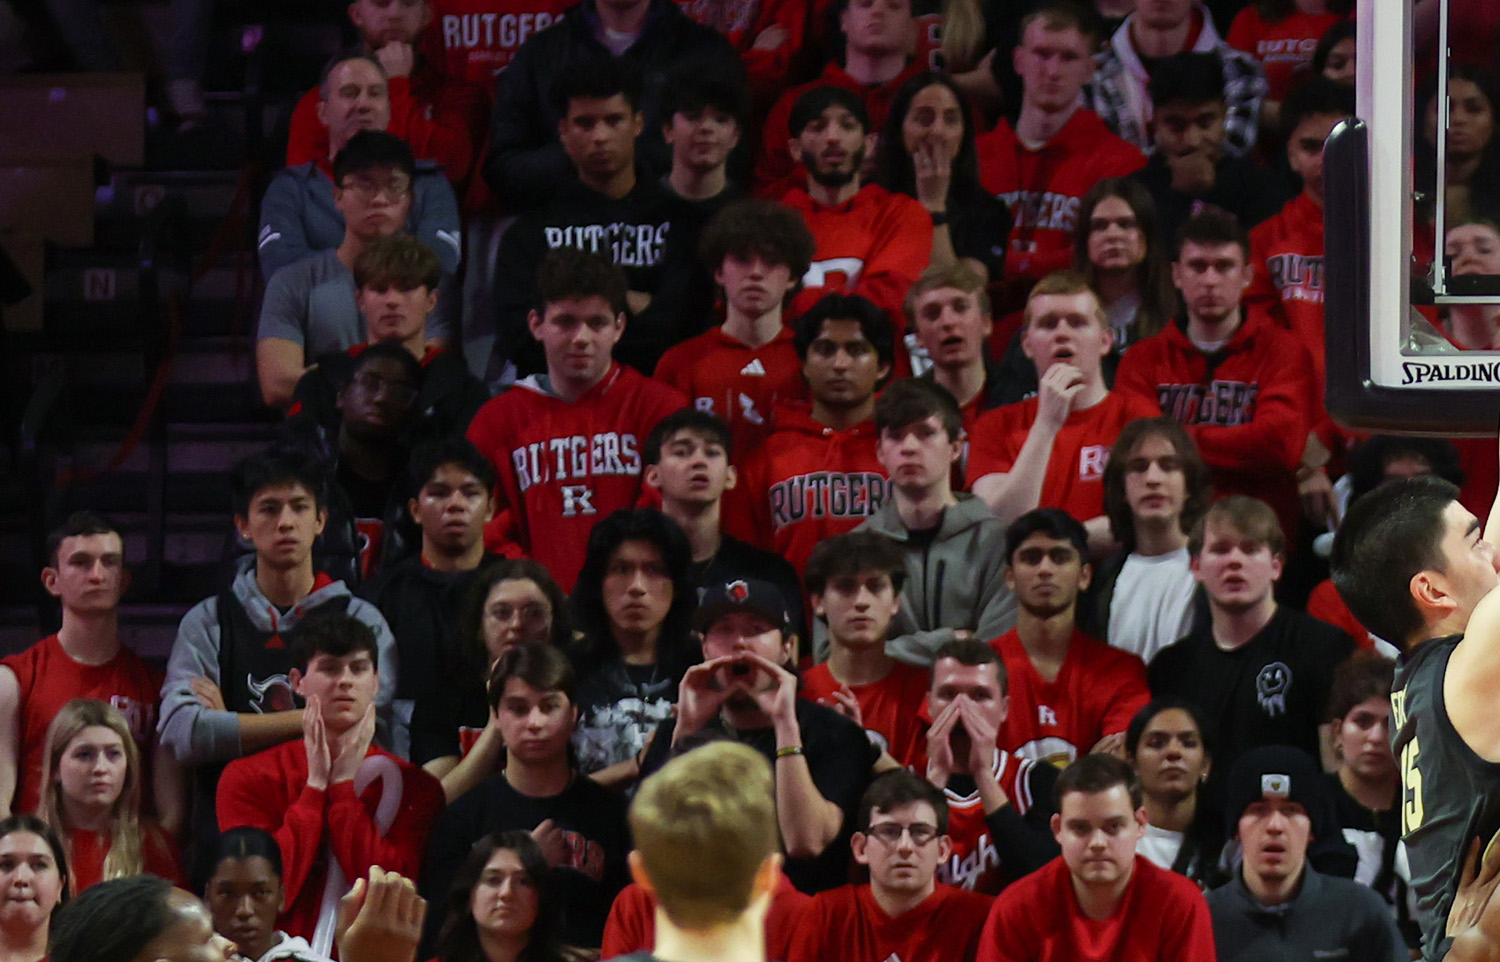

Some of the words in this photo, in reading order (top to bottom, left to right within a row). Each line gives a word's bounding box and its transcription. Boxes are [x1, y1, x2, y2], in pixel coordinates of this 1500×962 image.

[512, 431, 641, 492] RUTGERS
[561, 485, 598, 517] R
[768, 471, 894, 528] RUTGER
